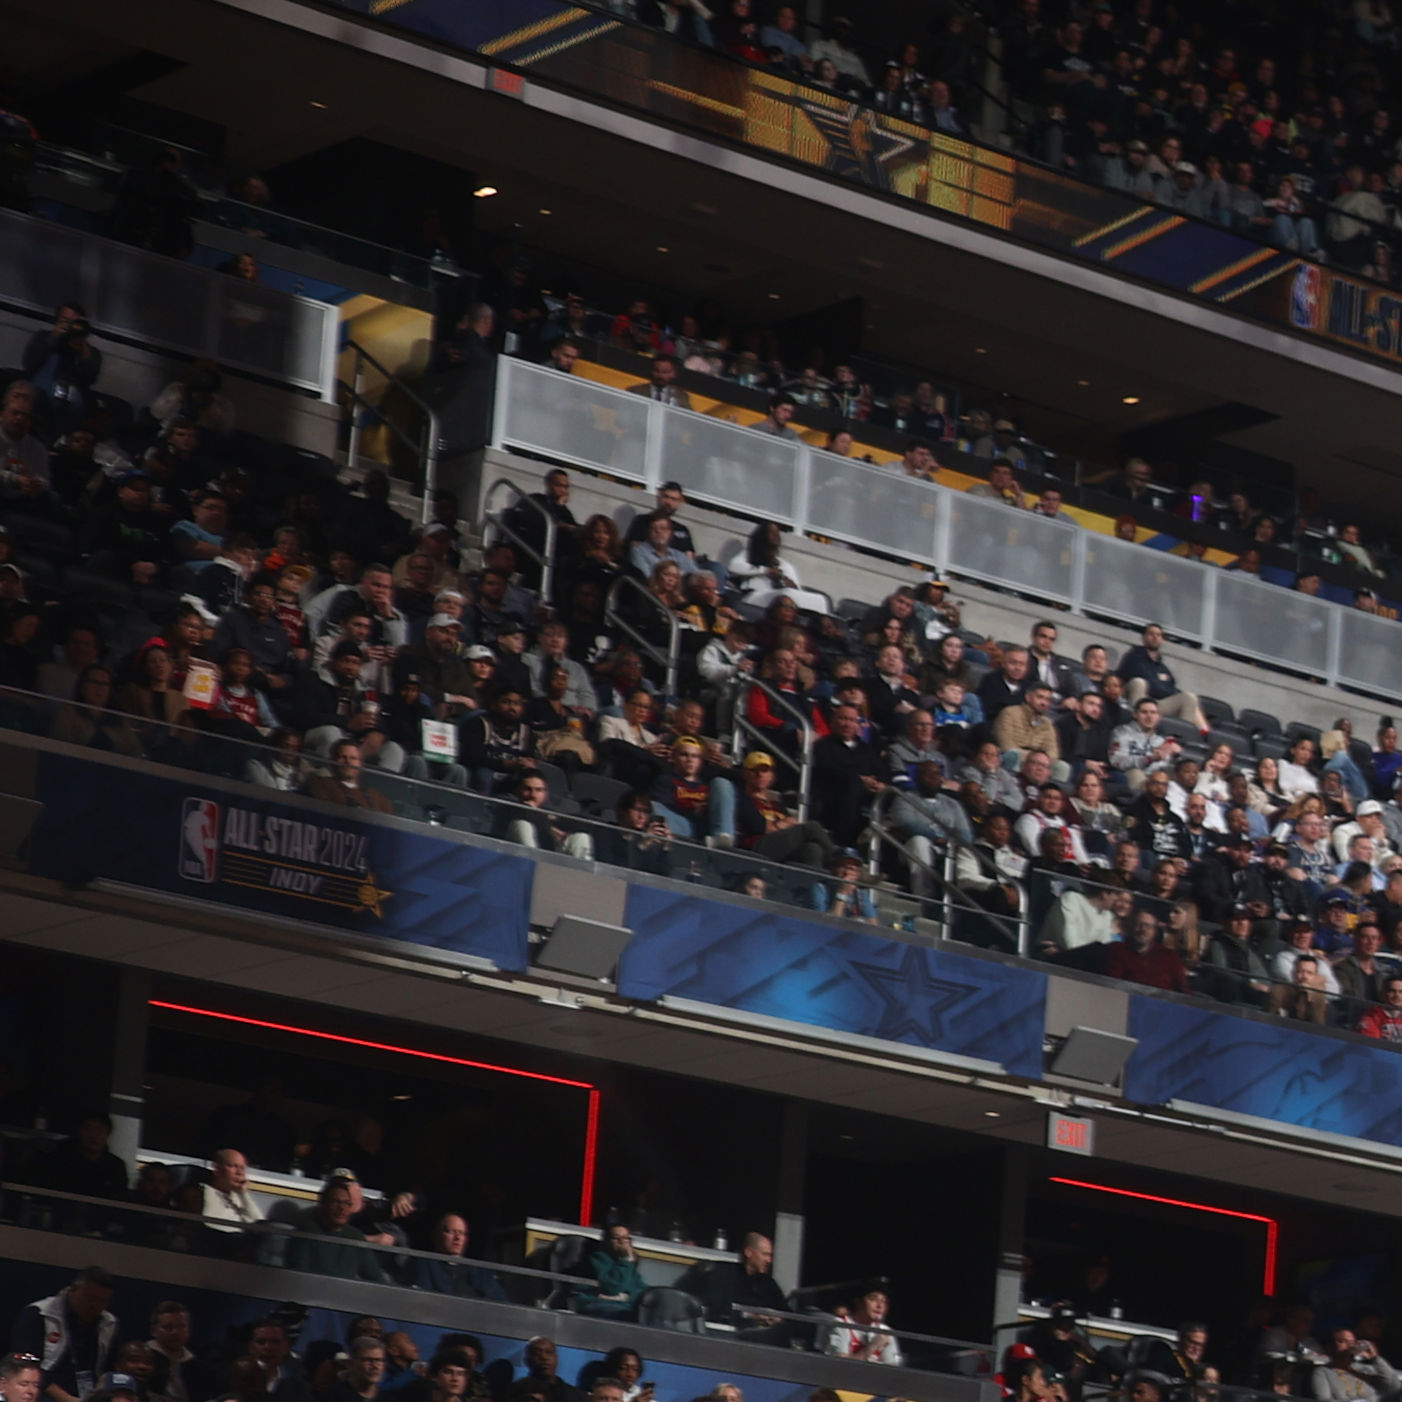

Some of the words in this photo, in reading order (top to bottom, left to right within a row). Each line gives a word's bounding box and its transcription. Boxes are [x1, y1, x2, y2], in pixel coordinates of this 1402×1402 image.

[223, 807, 319, 864] ALL-STAR
[319, 828, 369, 873] 2024
[268, 867, 323, 894] INDY
[1056, 1119, 1088, 1147] EXIT
